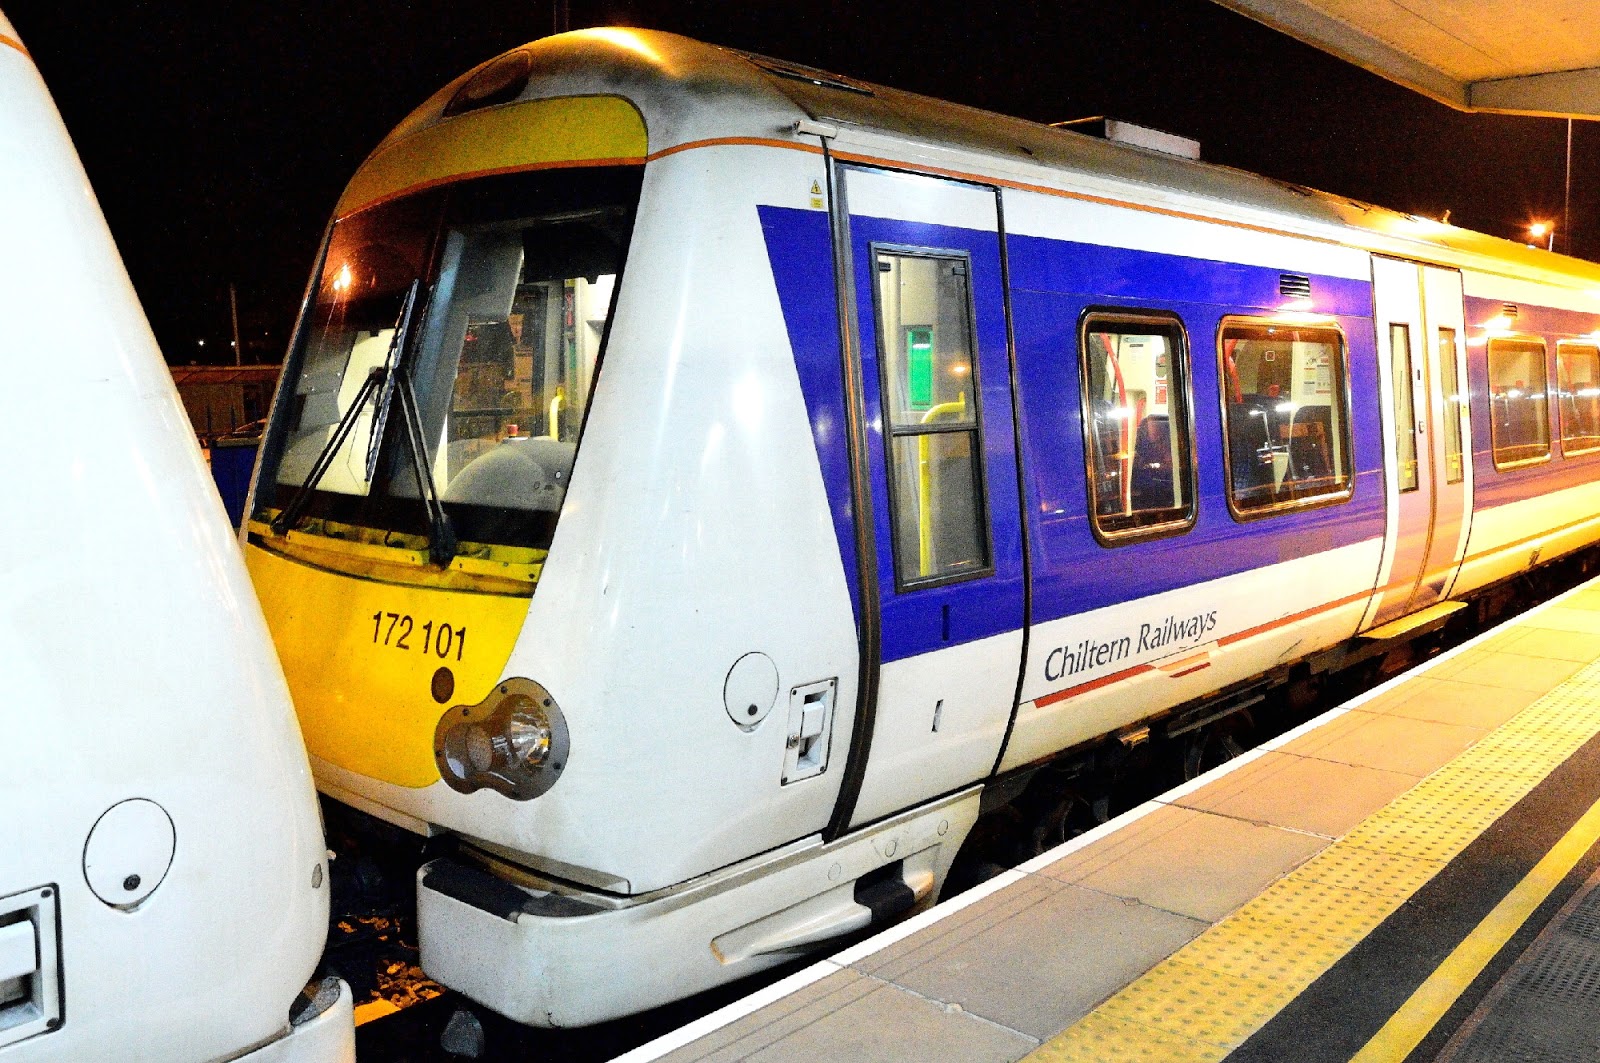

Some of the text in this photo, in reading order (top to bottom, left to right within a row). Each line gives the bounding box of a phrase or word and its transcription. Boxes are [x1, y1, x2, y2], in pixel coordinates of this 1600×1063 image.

[373, 611, 466, 661] 172 101
[1044, 610, 1217, 682] Chiltern Railways
